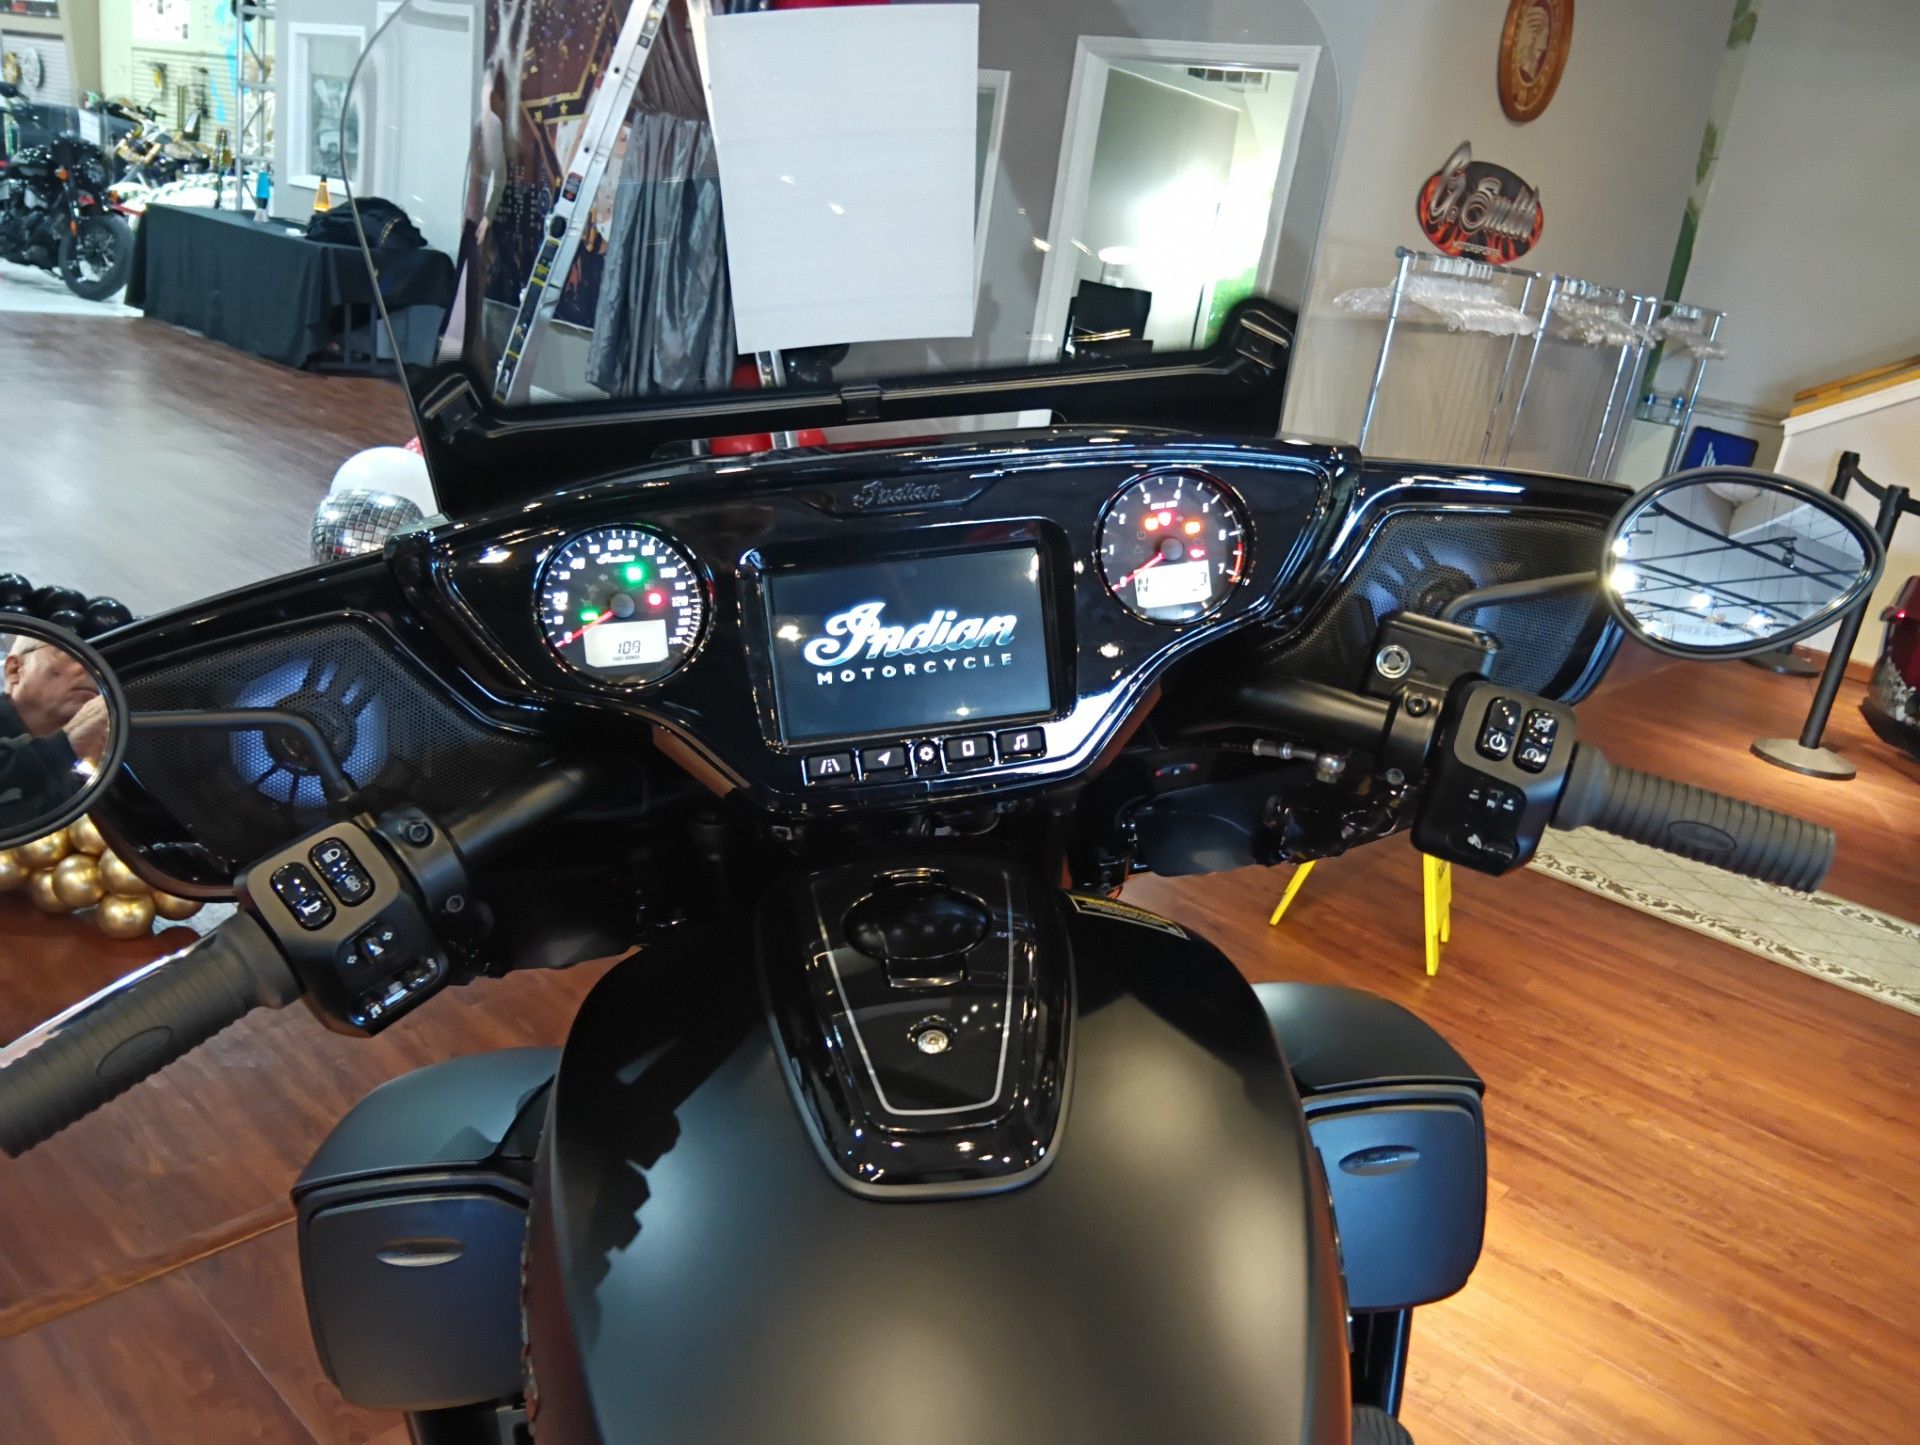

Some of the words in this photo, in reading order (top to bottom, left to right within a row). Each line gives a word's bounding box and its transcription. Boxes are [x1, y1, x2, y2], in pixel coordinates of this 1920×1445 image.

[1143, 493, 1151, 504] 3
[1173, 489, 1181, 500] 4
[1202, 503, 1209, 512] 5
[1119, 513, 1126, 524] 2
[1109, 545, 1114, 555] 1
[1218, 563, 1225, 574] 7
[804, 601, 1018, 667] Indian
[817, 652, 1013, 686] MOTORCYCLE
